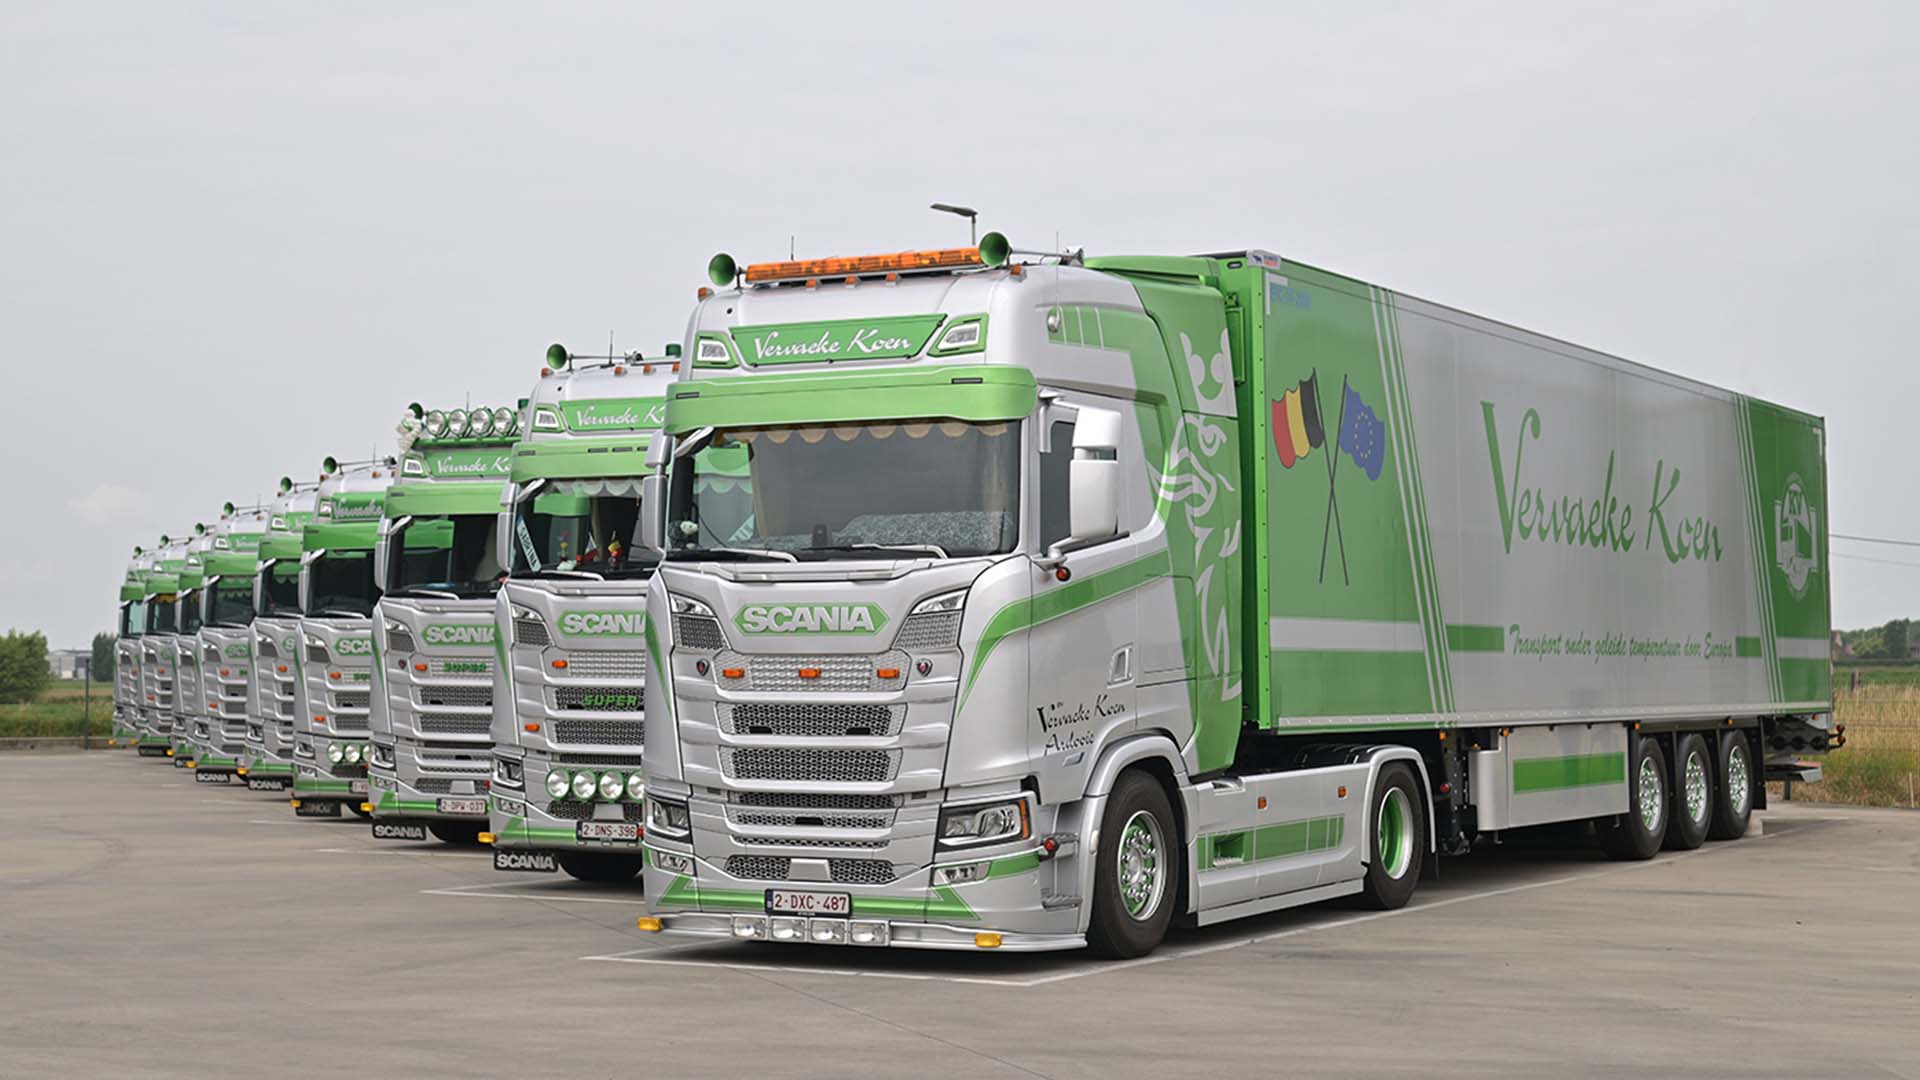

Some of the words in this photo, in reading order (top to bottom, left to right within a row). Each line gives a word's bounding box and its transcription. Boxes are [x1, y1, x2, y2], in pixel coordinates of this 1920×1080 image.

[754, 331, 840, 359] Vervaeke
[846, 328, 912, 353] Koen
[1479, 400, 1636, 554] Vervaeke
[1645, 458, 1723, 564] Koen
[563, 613, 646, 634] SCANI
[742, 606, 876, 633] SCANIA
[1509, 623, 1562, 663] Transport
[583, 694, 637, 706] SUPER
[1093, 693, 1126, 718] Koen
[374, 824, 424, 839] SCANIA
[583, 824, 636, 838] 2-DNS-396
[496, 853, 555, 870] SCANIA
[774, 893, 848, 911] 2-DXC-487
